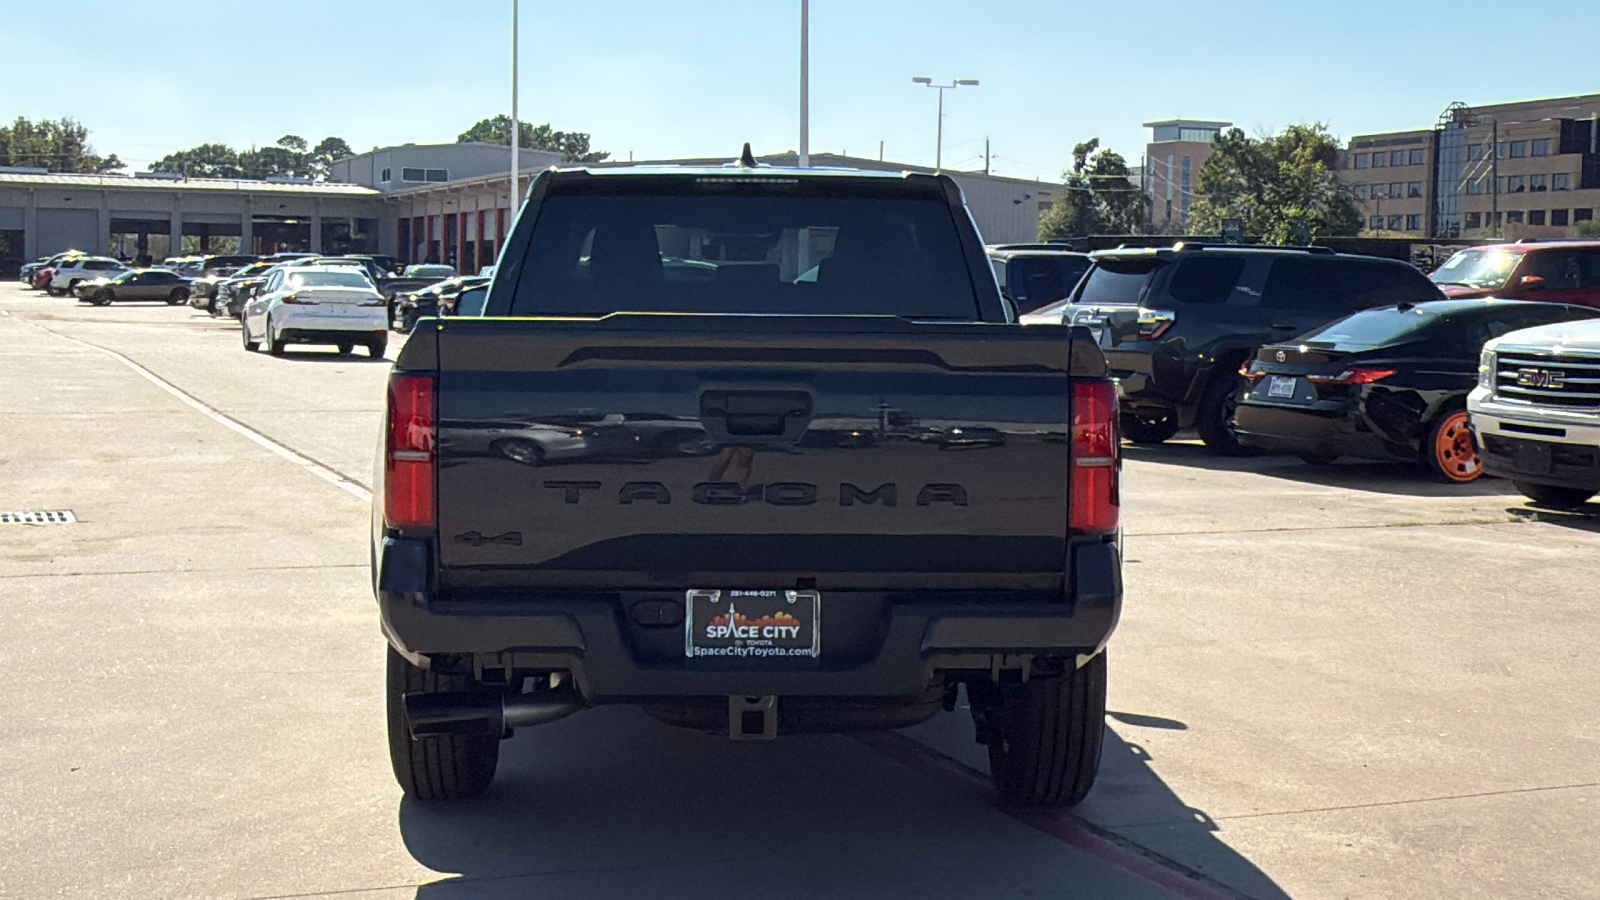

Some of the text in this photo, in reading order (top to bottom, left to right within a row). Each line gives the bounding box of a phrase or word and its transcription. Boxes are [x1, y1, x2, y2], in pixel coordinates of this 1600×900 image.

[1517, 368, 1565, 388] GMC
[543, 480, 968, 506] TACOMA
[706, 625, 800, 638] SPACE CITY
[694, 646, 812, 658] SpaceCityToyota.com
